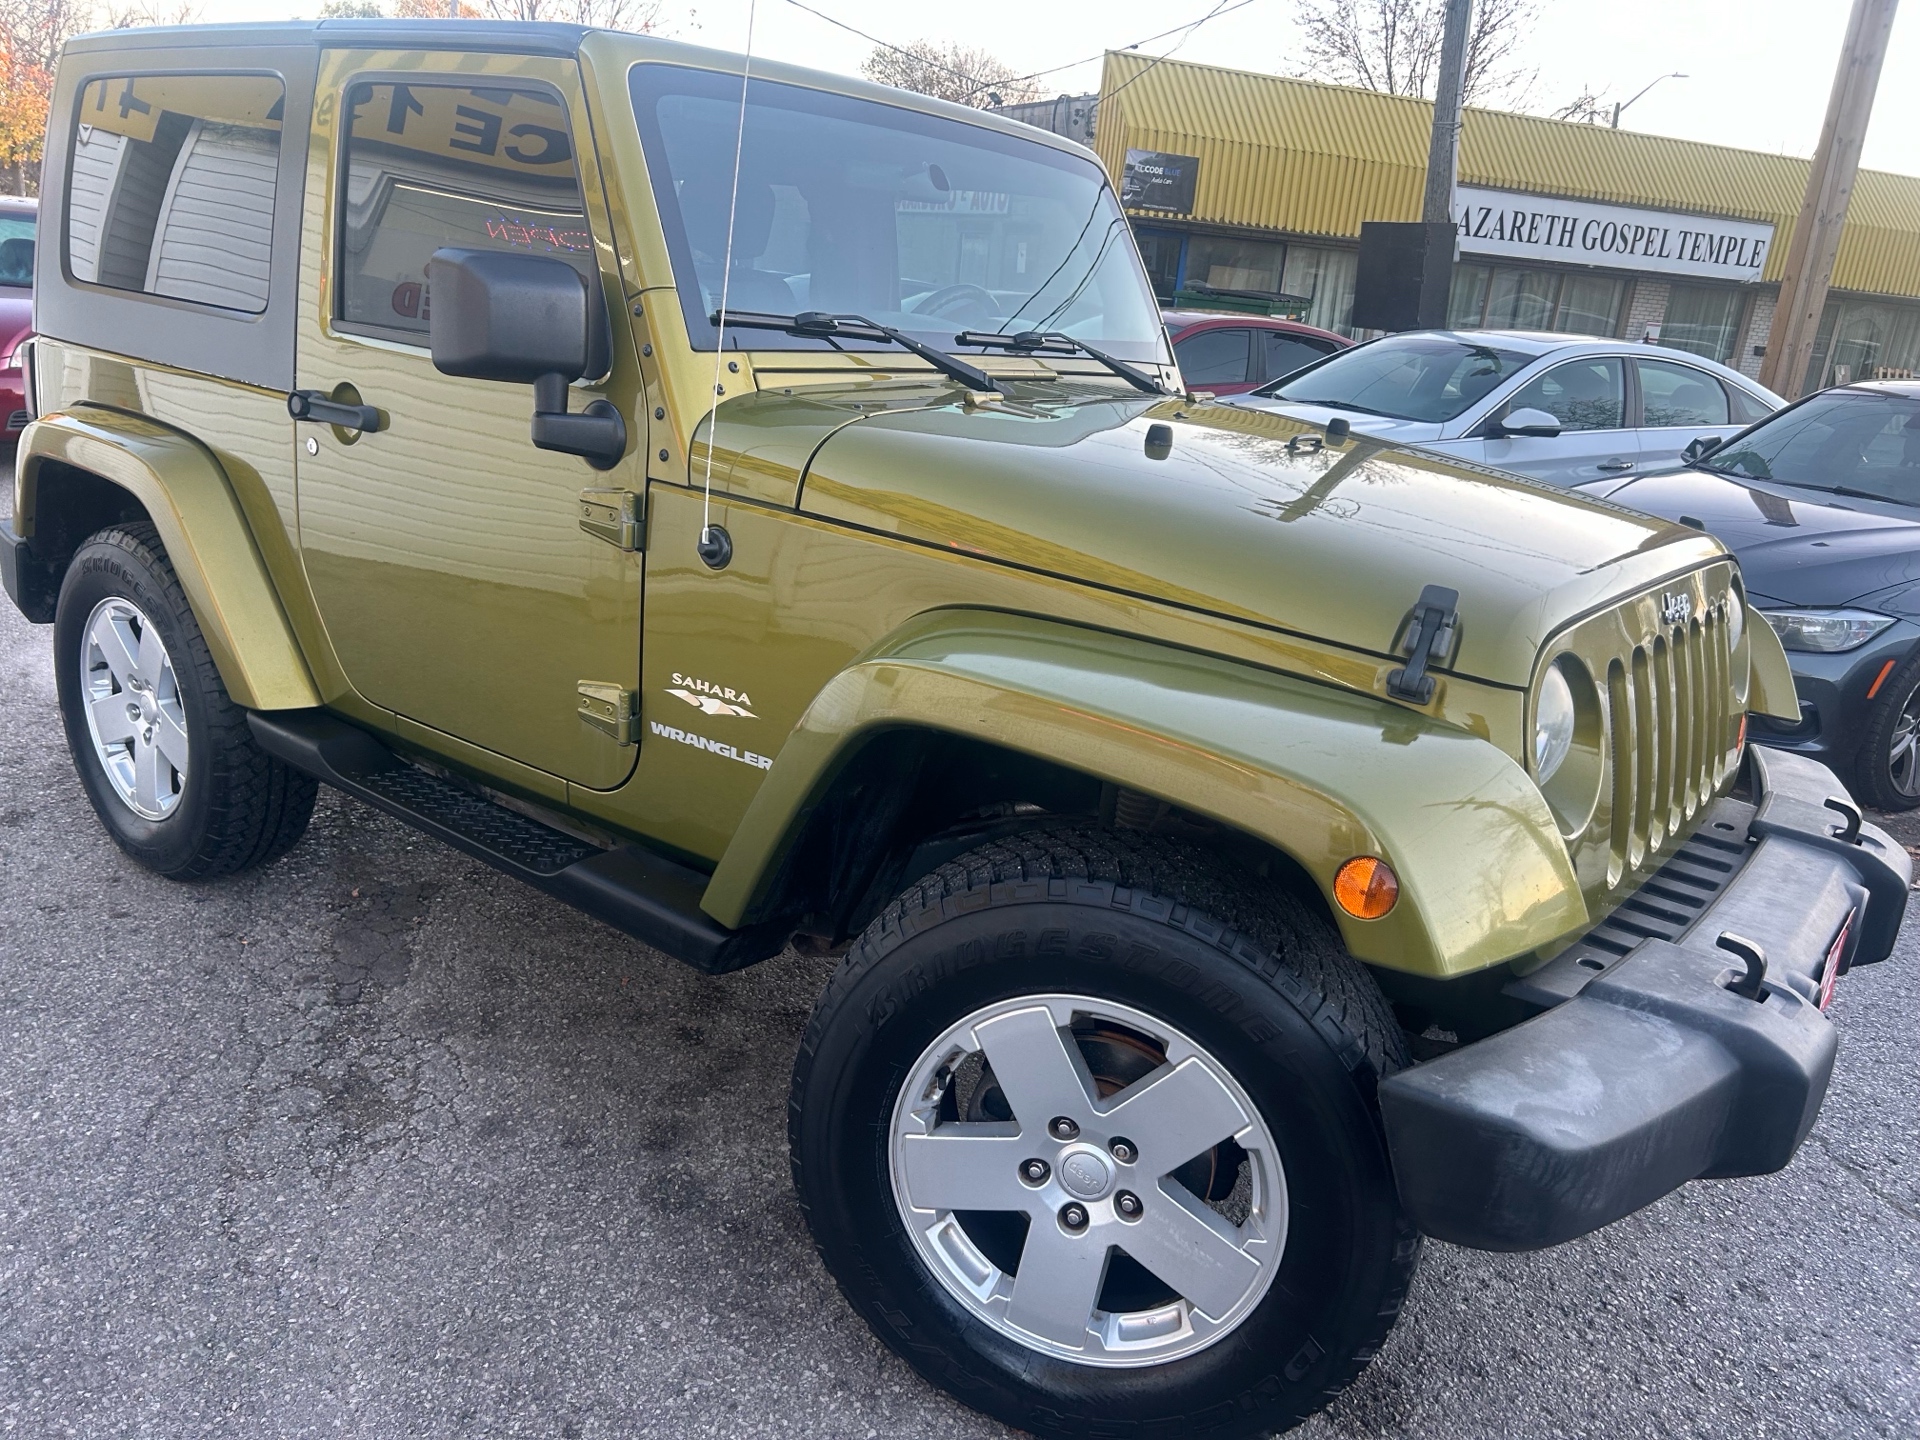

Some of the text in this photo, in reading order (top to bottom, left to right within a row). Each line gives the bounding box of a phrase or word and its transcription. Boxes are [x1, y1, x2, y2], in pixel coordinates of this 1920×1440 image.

[1456, 205, 1766, 269] AZARETH GOSPEL TEMPLE
[1661, 592, 1691, 624] Jeep
[671, 672, 752, 706] SAHARA
[650, 720, 774, 771] WRANGLER
[865, 926, 1284, 1044] BRIDGESTONE
[1068, 1161, 1101, 1189] Jeep
